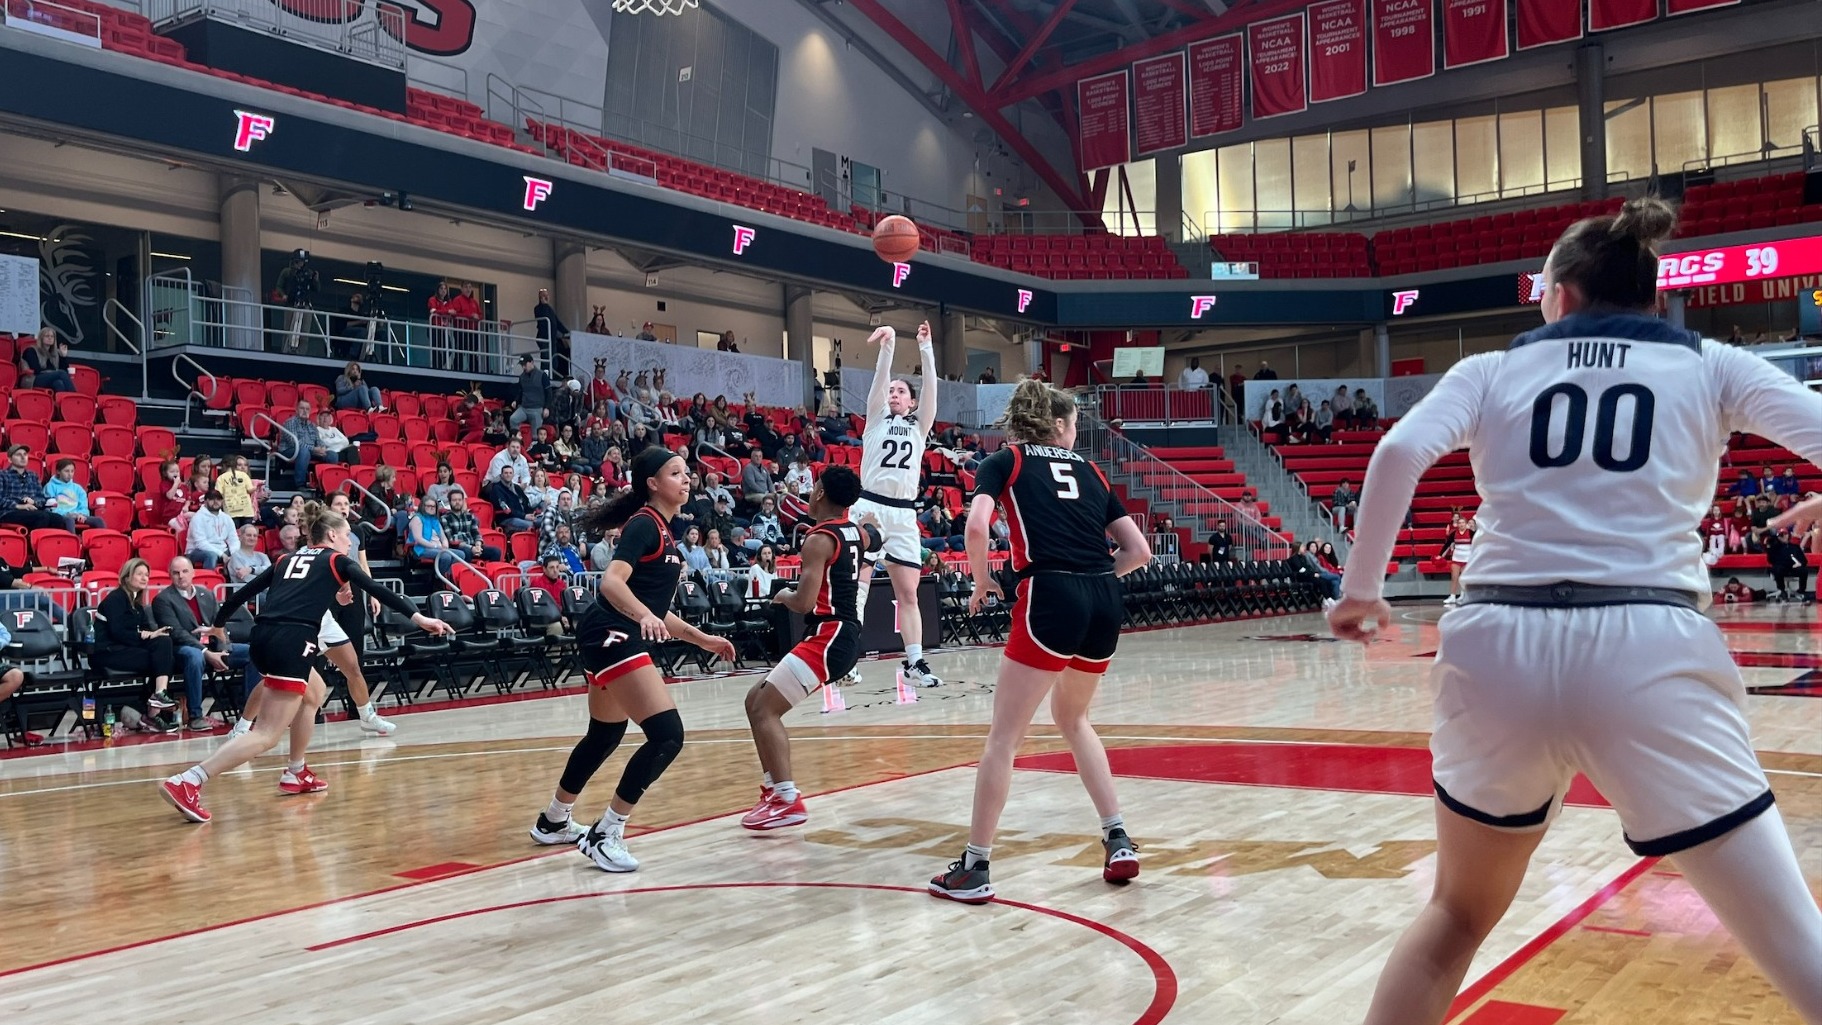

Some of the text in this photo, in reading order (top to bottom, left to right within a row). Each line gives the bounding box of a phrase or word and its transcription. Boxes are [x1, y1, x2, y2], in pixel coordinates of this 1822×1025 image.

[1386, 0, 1418, 13] NCAA
[1462, 4, 1486, 18] 1991
[1321, 17, 1352, 31] NCAA
[1390, 25, 1415, 38] 1998
[1261, 36, 1291, 50] NCAA
[1325, 43, 1350, 56] 2001
[1264, 61, 1290, 74] 2022
[233, 109, 274, 152] F
[522, 175, 553, 211] F
[732, 224, 755, 256] F
[1745, 246, 1778, 277] 39
[892, 261, 911, 288] F
[1017, 288, 1033, 313] F
[1190, 295, 1217, 319] F
[1392, 289, 1419, 315] F
[1567, 341, 1632, 370] HUNT
[887, 425, 912, 437] MOUNT
[1529, 382, 1656, 473] 00
[880, 439, 913, 470] 22
[1024, 443, 1086, 463] ANDERSEN
[1049, 462, 1080, 500] 5
[283, 555, 316, 580] 15
[849, 545, 859, 580] 3
[440, 593, 454, 607] F
[487, 591, 500, 605] F
[530, 589, 543, 603] F
[13, 611, 34, 629] F
[601, 628, 630, 648] F
[301, 640, 317, 657] F
